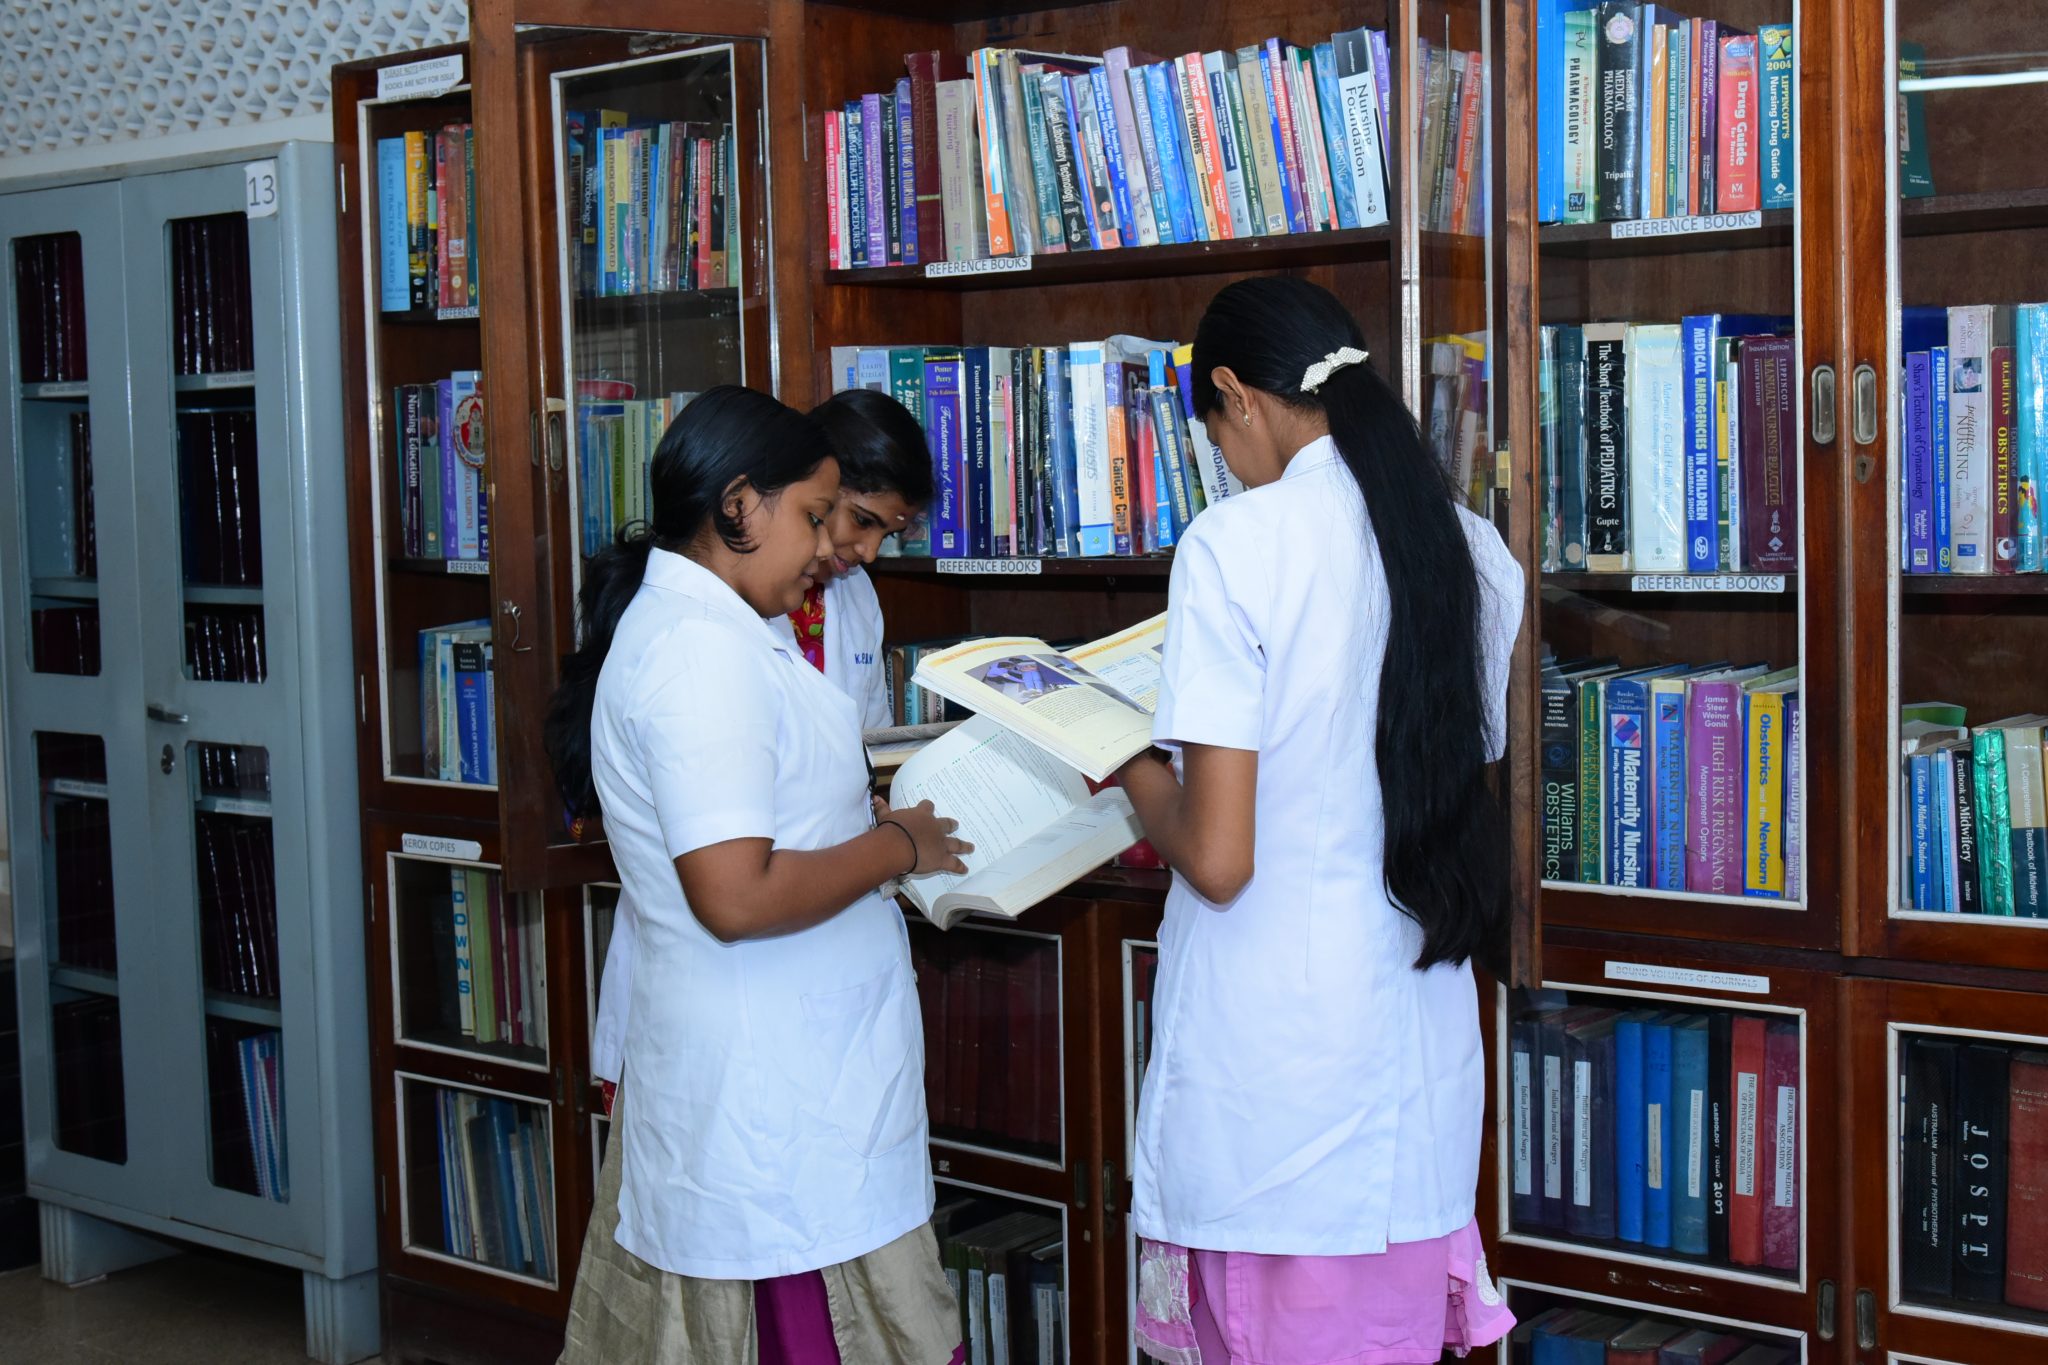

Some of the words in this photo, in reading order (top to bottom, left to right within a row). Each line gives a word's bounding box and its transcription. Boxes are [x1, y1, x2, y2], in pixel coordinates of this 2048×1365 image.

[385, 81, 403, 91] BOOKS
[404, 80, 414, 88] ARE
[416, 78, 427, 87] NOT
[428, 76, 439, 84] FOR
[1766, 62, 1792, 71] 2004
[1190, 78, 1200, 97] Nose
[1568, 57, 1581, 145] PHARMACOLOGY
[1614, 69, 1624, 113] MEDICAL
[1735, 80, 1748, 119] Drug
[1768, 75, 1779, 118] Nursing
[1047, 97, 1059, 124] Medical
[1357, 84, 1373, 146] Nursing
[1604, 70, 1614, 150] PHARMACOLOGY
[1781, 75, 1790, 139] LIPPINCOTT'S
[1052, 123, 1067, 162] Laboratory
[1197, 116, 1208, 139] Throat
[1346, 87, 1366, 177] Foundation
[1736, 122, 1748, 166] Guide
[1769, 119, 1780, 146] Drug
[1201, 141, 1215, 175] Diseases
[1729, 140, 1737, 166] Nurses
[1771, 148, 1780, 179] Guide
[249, 175, 276, 206] 13
[1056, 162, 1075, 203] Technology
[1605, 171, 1634, 181] Tripathi
[583, 168, 593, 225] Microbiology
[1615, 216, 1698, 238] REFERENCE
[1701, 211, 1757, 231] BOOKS
[929, 258, 991, 276] REFERENCE
[991, 255, 1029, 271] BOOKS
[1599, 343, 1611, 361] The
[1693, 328, 1707, 375] MEDICAL
[974, 365, 983, 414] Foundations
[1598, 362, 1611, 387] Short
[1764, 358, 1777, 401] MANUAL
[1779, 358, 1788, 412] LIPPINCOTT
[1912, 363, 1925, 392] Shaw's
[407, 395, 418, 433] Nursing
[976, 416, 983, 426] of
[1160, 402, 1171, 432] SENIOR
[1599, 389, 1612, 432] Textbook
[1695, 377, 1707, 449] EMERGENCIES
[1914, 394, 1924, 433] Textbook
[1965, 404, 1976, 452] pediatric
[976, 428, 984, 468] NURSING
[1599, 433, 1613, 444] of
[1765, 407, 1777, 457] NURSING
[1914, 434, 1925, 445] of
[1955, 415, 1968, 481] NURSING
[408, 438, 419, 487] Education
[1166, 434, 1179, 469] NURSING
[1696, 452, 1707, 466] IN
[1599, 446, 1616, 509] PEDIATRICS
[1768, 457, 1780, 506] PRACTICE
[1911, 445, 1927, 499] Gynaecology
[1997, 426, 2007, 514] OBSTETRICS
[1172, 472, 1189, 523] PROCEDURES
[1696, 467, 1708, 521] CHILDREN
[1596, 517, 1620, 526] Gupte
[939, 559, 999, 572] REFERENCE
[1001, 559, 1037, 572] BOOKS
[1637, 575, 1721, 591] REFERENCE
[1725, 575, 1779, 591] BOOKS
[1704, 695, 1729, 703] James
[1705, 720, 1728, 728] Gonik
[1588, 729, 1600, 800] MATERNITY
[1669, 729, 1681, 814] MATERNITY
[1712, 735, 1724, 772] HIGH
[1620, 749, 1641, 828] Maternity
[1712, 777, 1725, 806] RISK
[1917, 775, 1925, 795] Guide
[1957, 758, 1966, 795] Textbook
[1699, 765, 1709, 825] Management
[1918, 795, 1925, 803] to
[1959, 796, 1968, 805] of
[2021, 770, 2032, 827] Comprehensive
[1546, 782, 1560, 880] OBSTETRICS
[1561, 782, 1575, 850] Williams
[1589, 804, 1599, 864] NURSING
[1916, 804, 1926, 840] Midwifery
[404, 838, 428, 851] XEROX
[429, 841, 456, 853] COPIES
[1700, 827, 1709, 863] Options
[1712, 810, 1725, 893] PREGNANCY
[1960, 806, 1973, 863] Midwifery
[2025, 829, 2035, 861] Textbook
[1669, 820, 1681, 888] NURSING
[1918, 841, 1927, 874] Students
[2028, 862, 2036, 870] of
[2028, 871, 2038, 906] Midwifery
[1741, 1092, 1747, 1103] OF
[1747, 1090, 1755, 1122] JOURNAL
[1786, 1088, 1794, 1102] THE
[1739, 1104, 1747, 1144] PHYSICIANS
[1747, 1123, 1754, 1133] OF
[1786, 1103, 1794, 1133] JOURNAL
[1930, 1103, 1938, 1149] AUSTRALIAN
[1740, 1145, 1747, 1155] OF
[1786, 1134, 1793, 1145] OF
[1745, 1148, 1753, 1194] ASSOCIATION
[1930, 1151, 1938, 1177] Journal
[1931, 1178, 1938, 1186] of
[1784, 1172, 1792, 1206] MEDIACAL
[1930, 1188, 1938, 1248] PHYSIOTHERAPY
